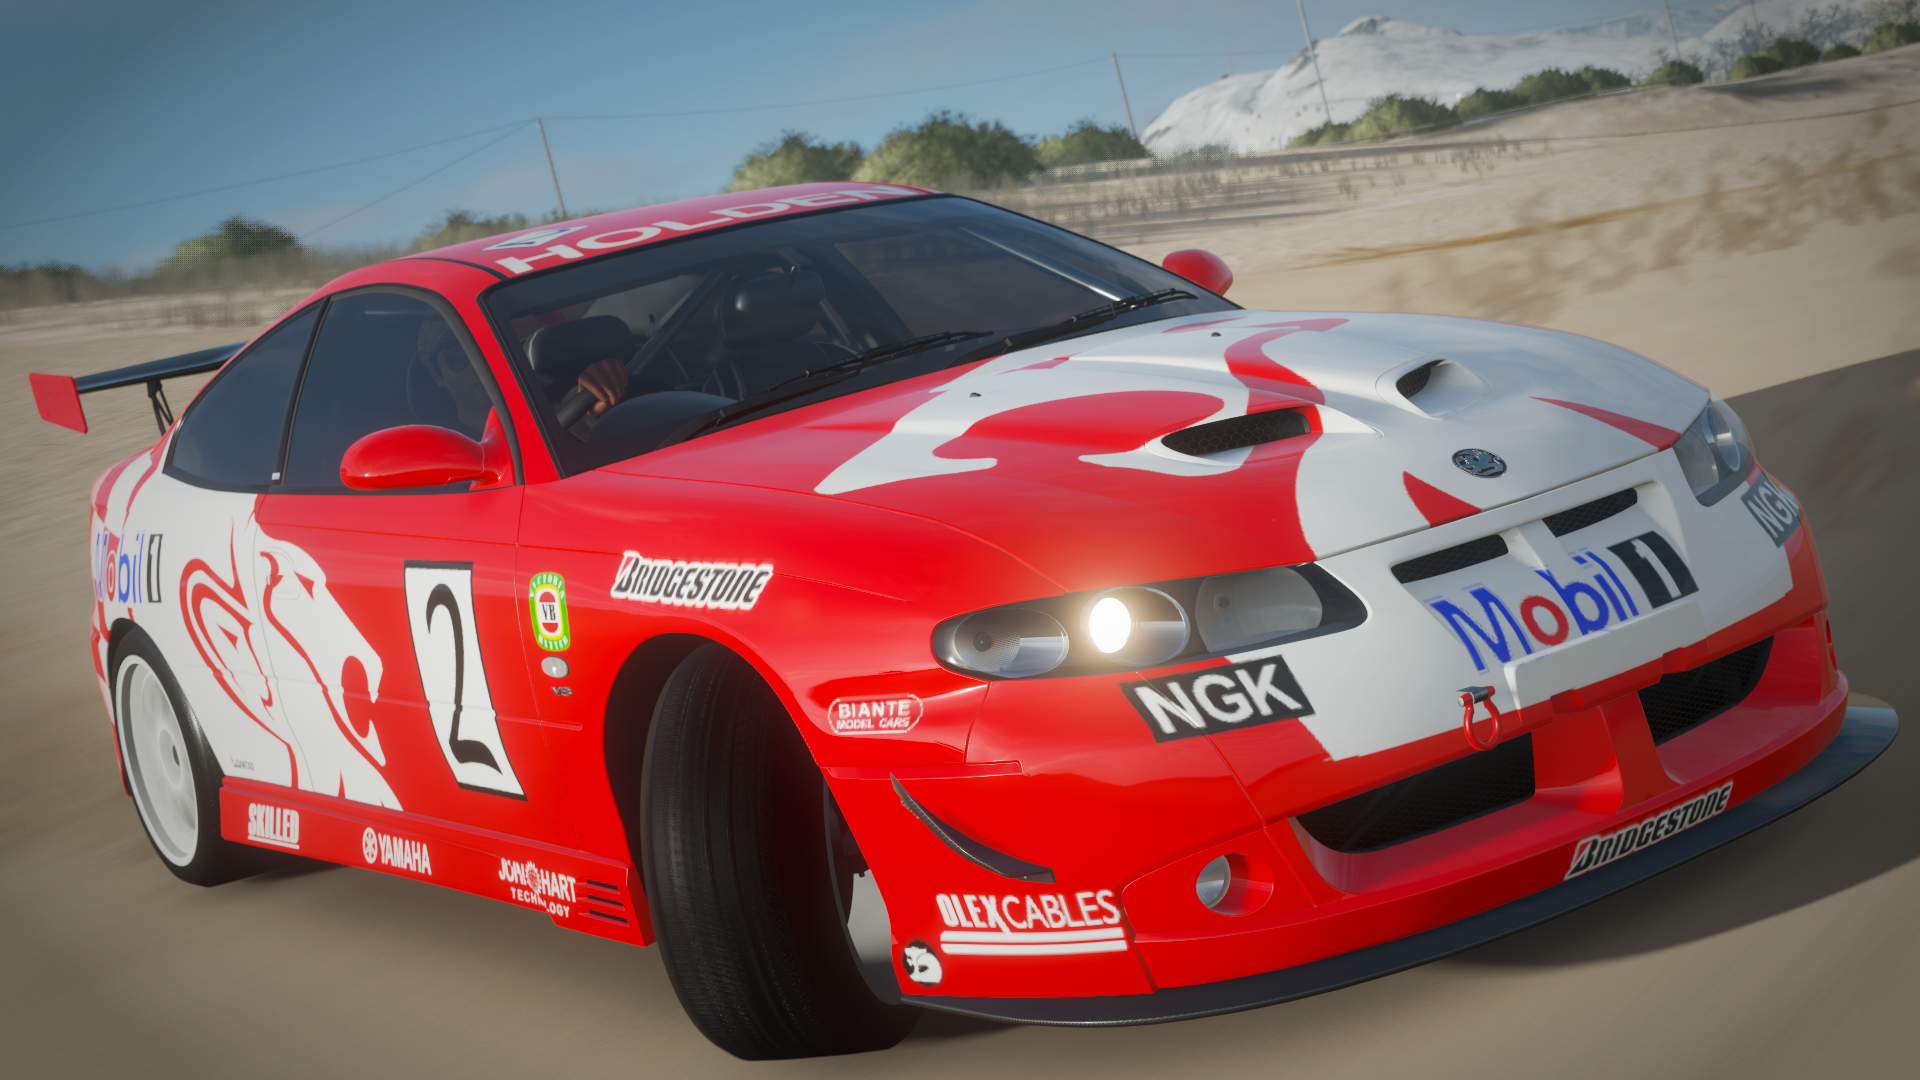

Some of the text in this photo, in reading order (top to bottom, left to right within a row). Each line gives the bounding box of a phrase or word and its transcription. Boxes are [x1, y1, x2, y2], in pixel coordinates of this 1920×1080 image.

[495, 186, 919, 274] HOLDEN
[611, 554, 772, 605] BRIDGESTONE
[1426, 534, 1688, 671] Mobil 1
[541, 604, 556, 621] VB
[426, 583, 503, 775] 2
[1134, 662, 1304, 735] NGK
[836, 716, 911, 730] MODEL CARS
[838, 700, 911, 719] BIANTE
[248, 802, 300, 840] SKILLED
[1565, 783, 1733, 878] BRIDGESTONE
[378, 828, 432, 876] YAMAHA
[540, 868, 577, 903] HART
